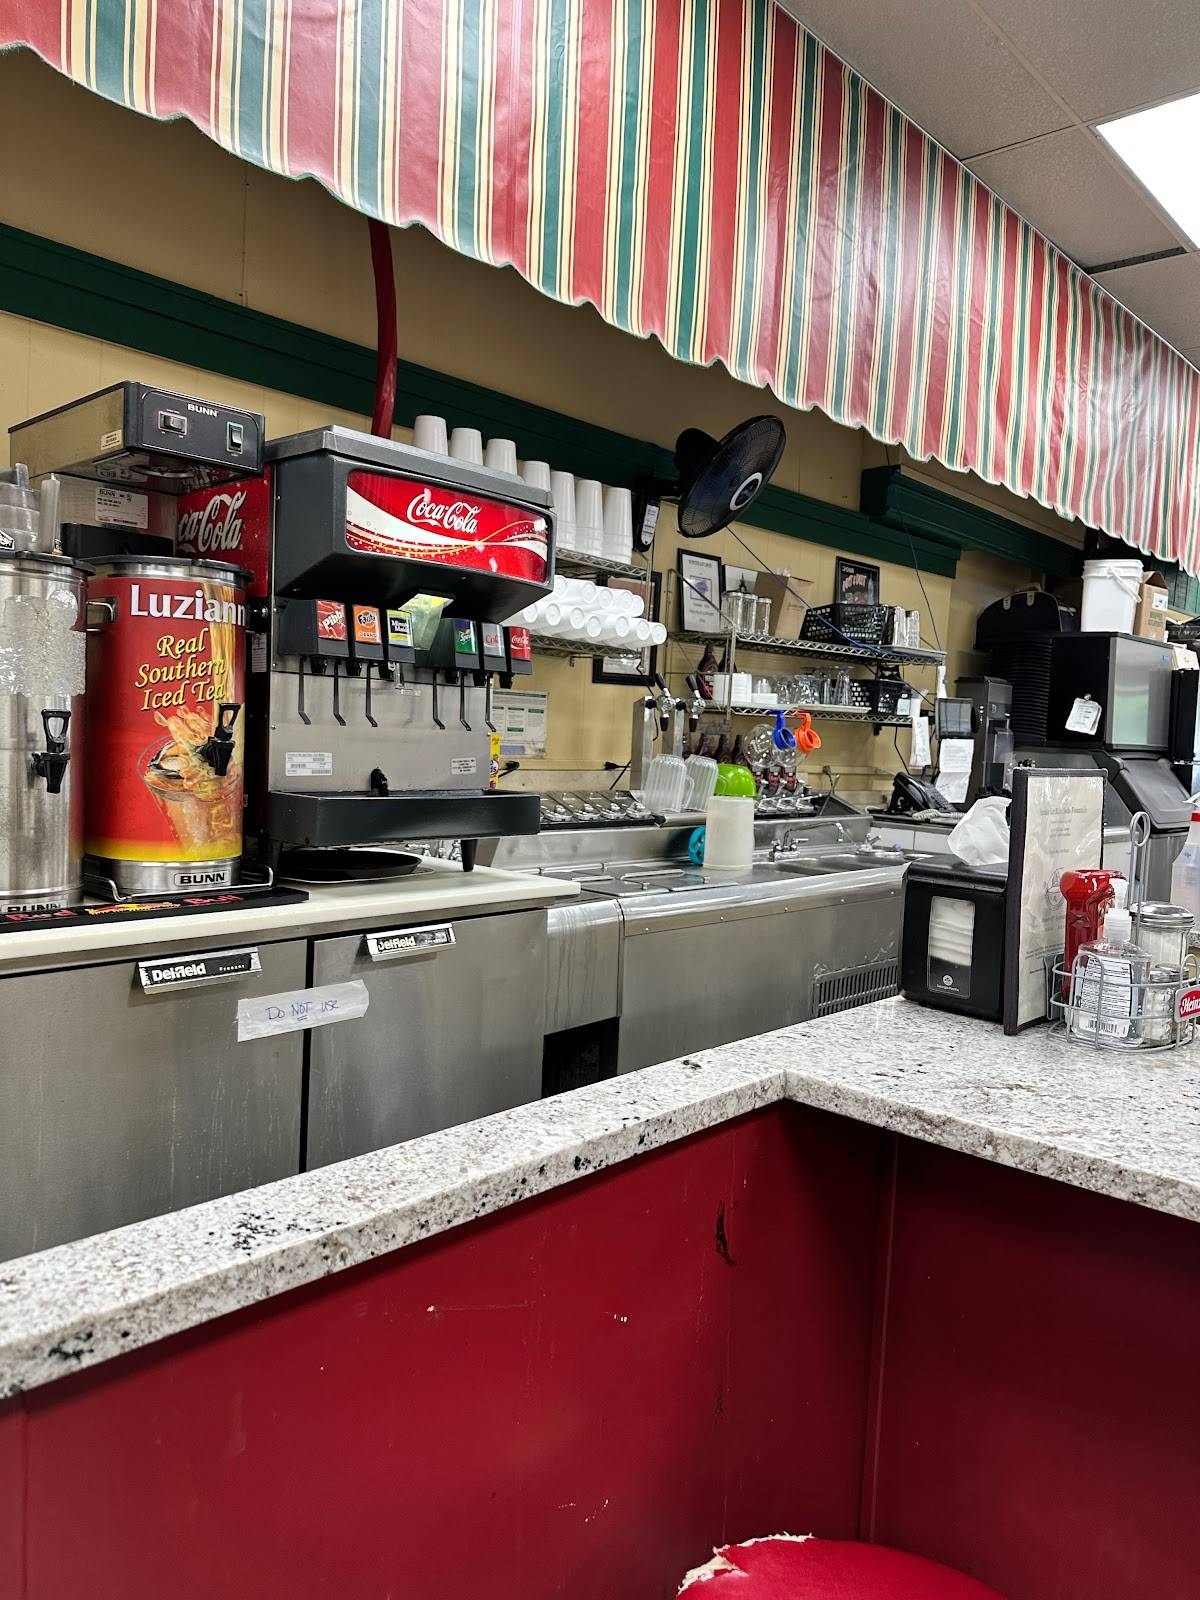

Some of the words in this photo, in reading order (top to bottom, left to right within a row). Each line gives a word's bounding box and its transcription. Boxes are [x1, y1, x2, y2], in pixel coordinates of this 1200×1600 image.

[187, 403, 219, 417] BUNN
[129, 583, 247, 627] Luziann
[156, 627, 209, 659] Real
[134, 656, 226, 688] Southern
[140, 683, 186, 711] Iced
[191, 682, 225, 704] Tea
[179, 871, 226, 886] BUNN
[151, 962, 207, 982] Delfield
[267, 1005, 286, 1021] Do
[291, 1001, 313, 1016] NOT
